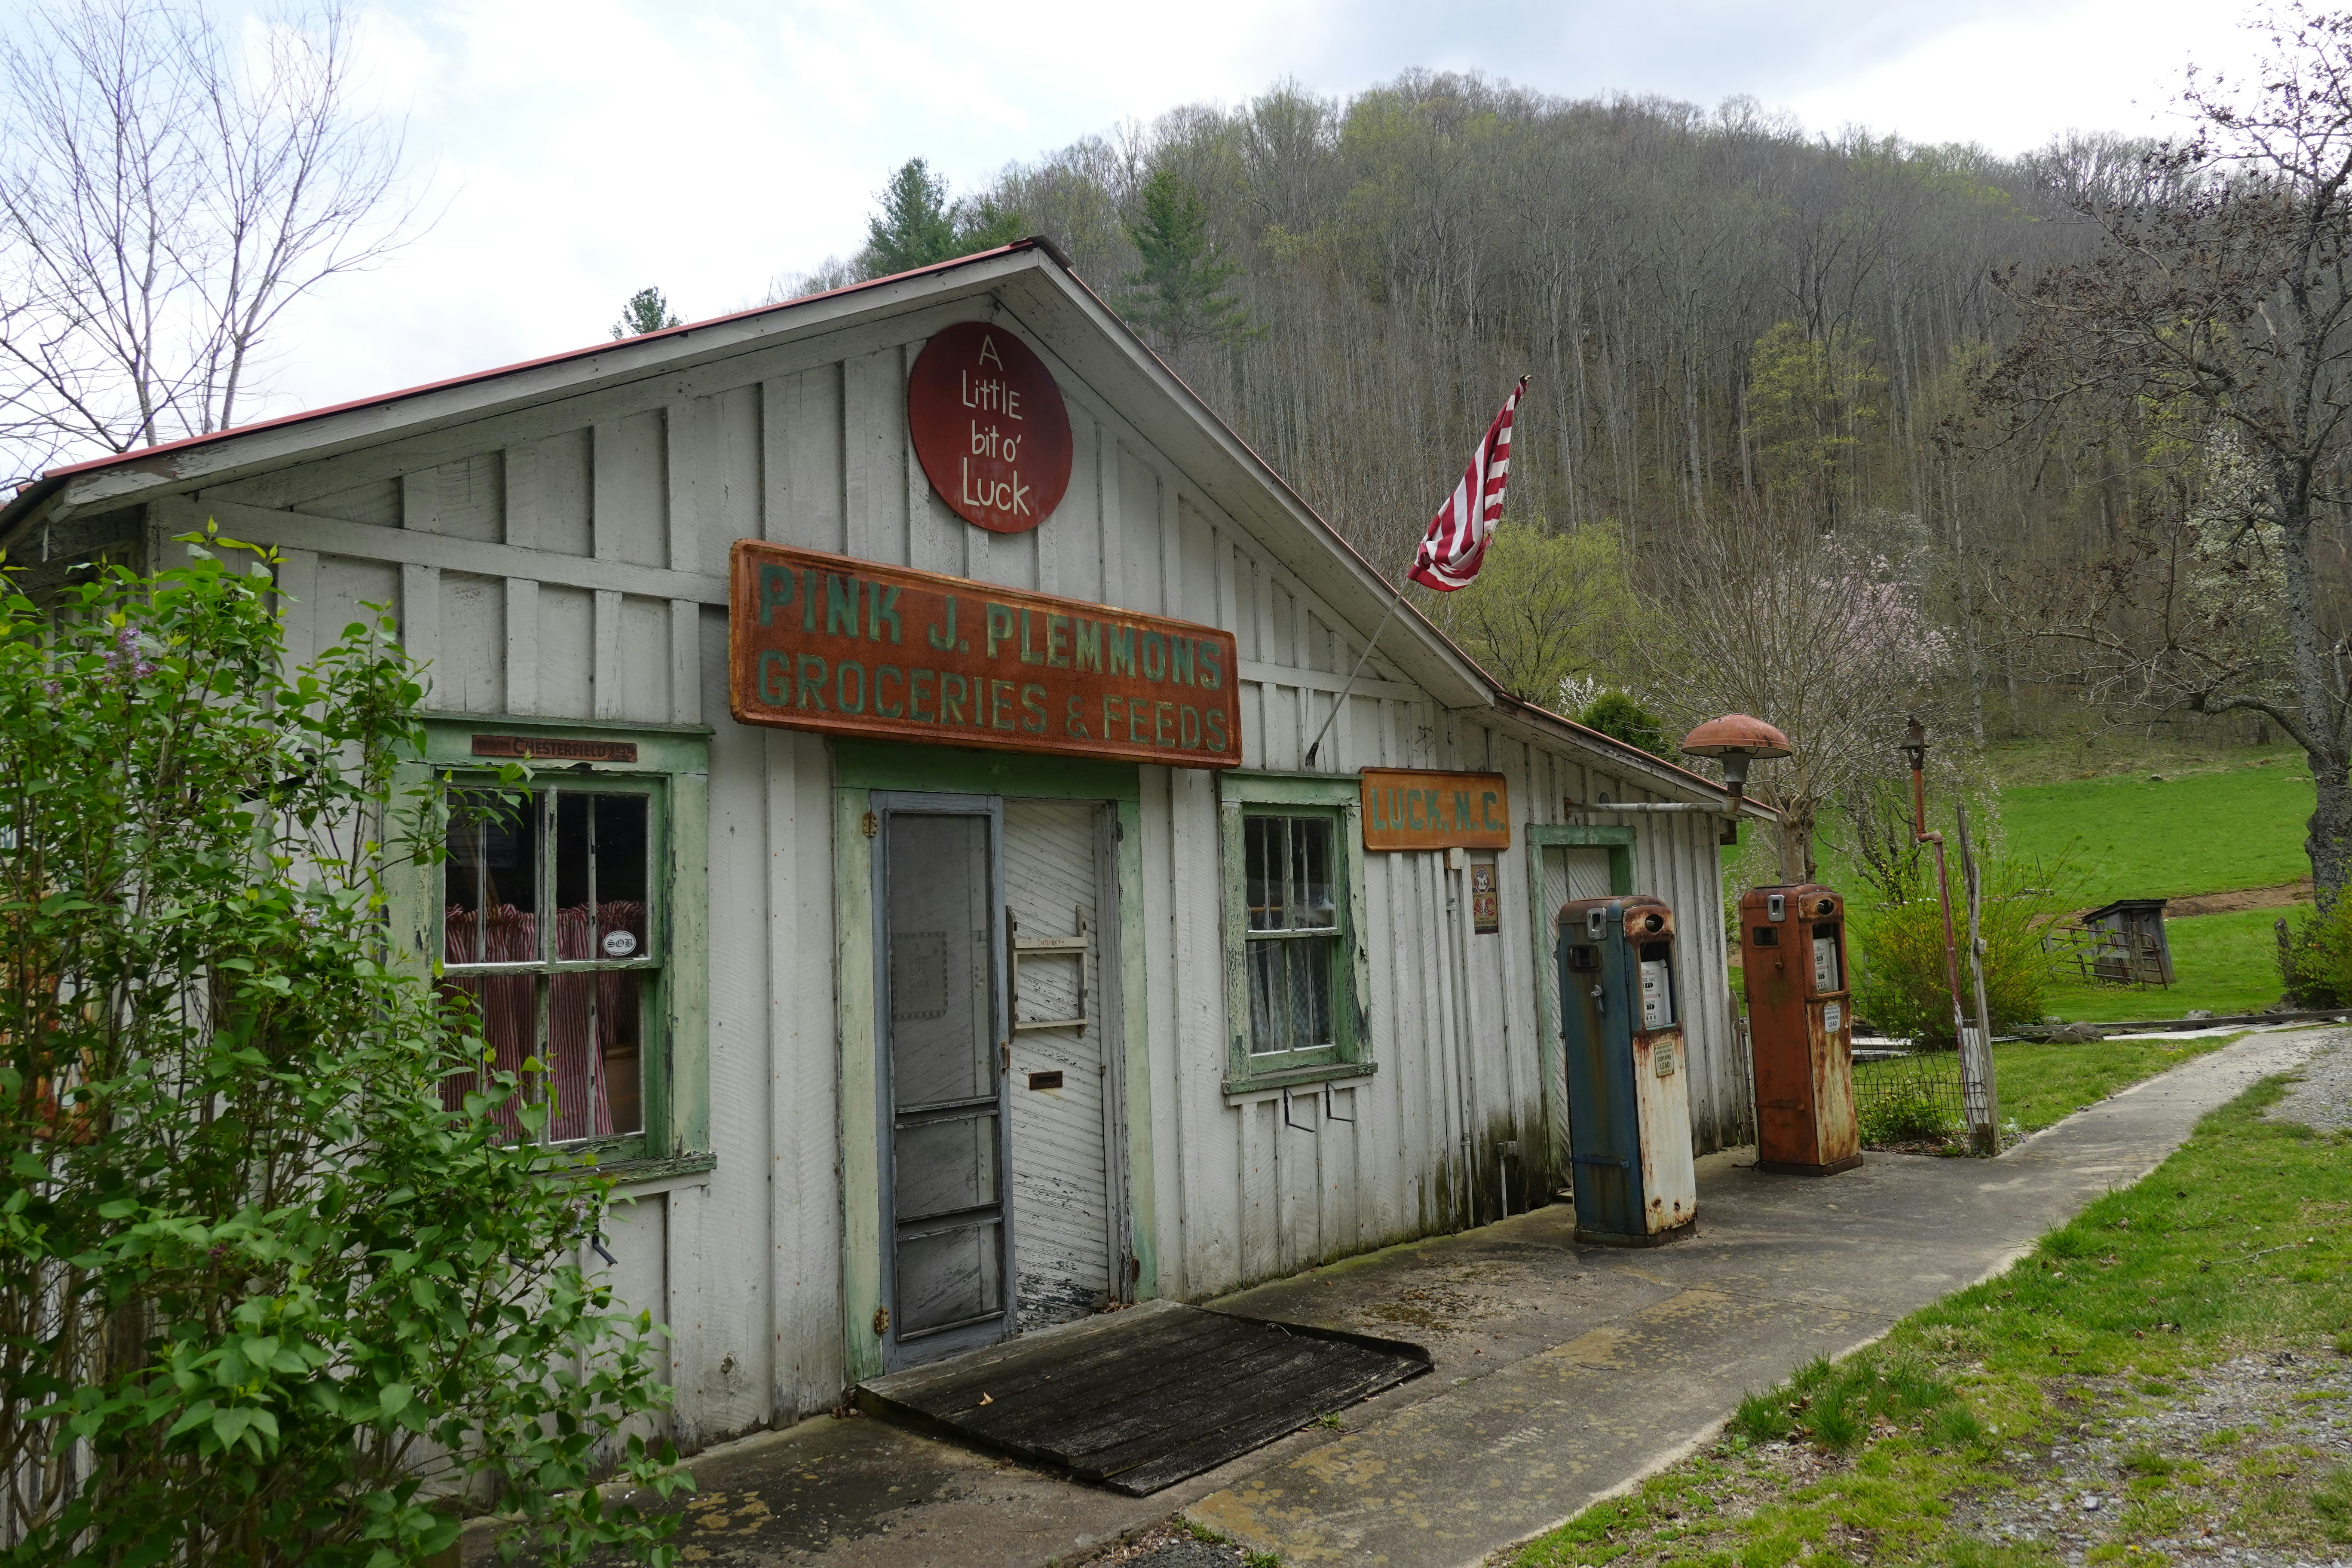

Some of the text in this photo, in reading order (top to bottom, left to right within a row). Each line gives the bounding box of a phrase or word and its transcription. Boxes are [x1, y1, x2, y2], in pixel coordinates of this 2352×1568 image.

[979, 334, 1003, 371] A
[972, 419, 1022, 462] bit o'
[963, 456, 1030, 516] Luck
[759, 562, 1221, 691] PINK J. PLEMMONS
[758, 649, 1225, 752] GROCERIES & FEEDS
[513, 737, 606, 757] CHESTERFIELD
[1372, 787, 1450, 835] LUCK,
[607, 939, 633, 949] SOB
[1657, 1054, 1671, 1062] CONTAINS
